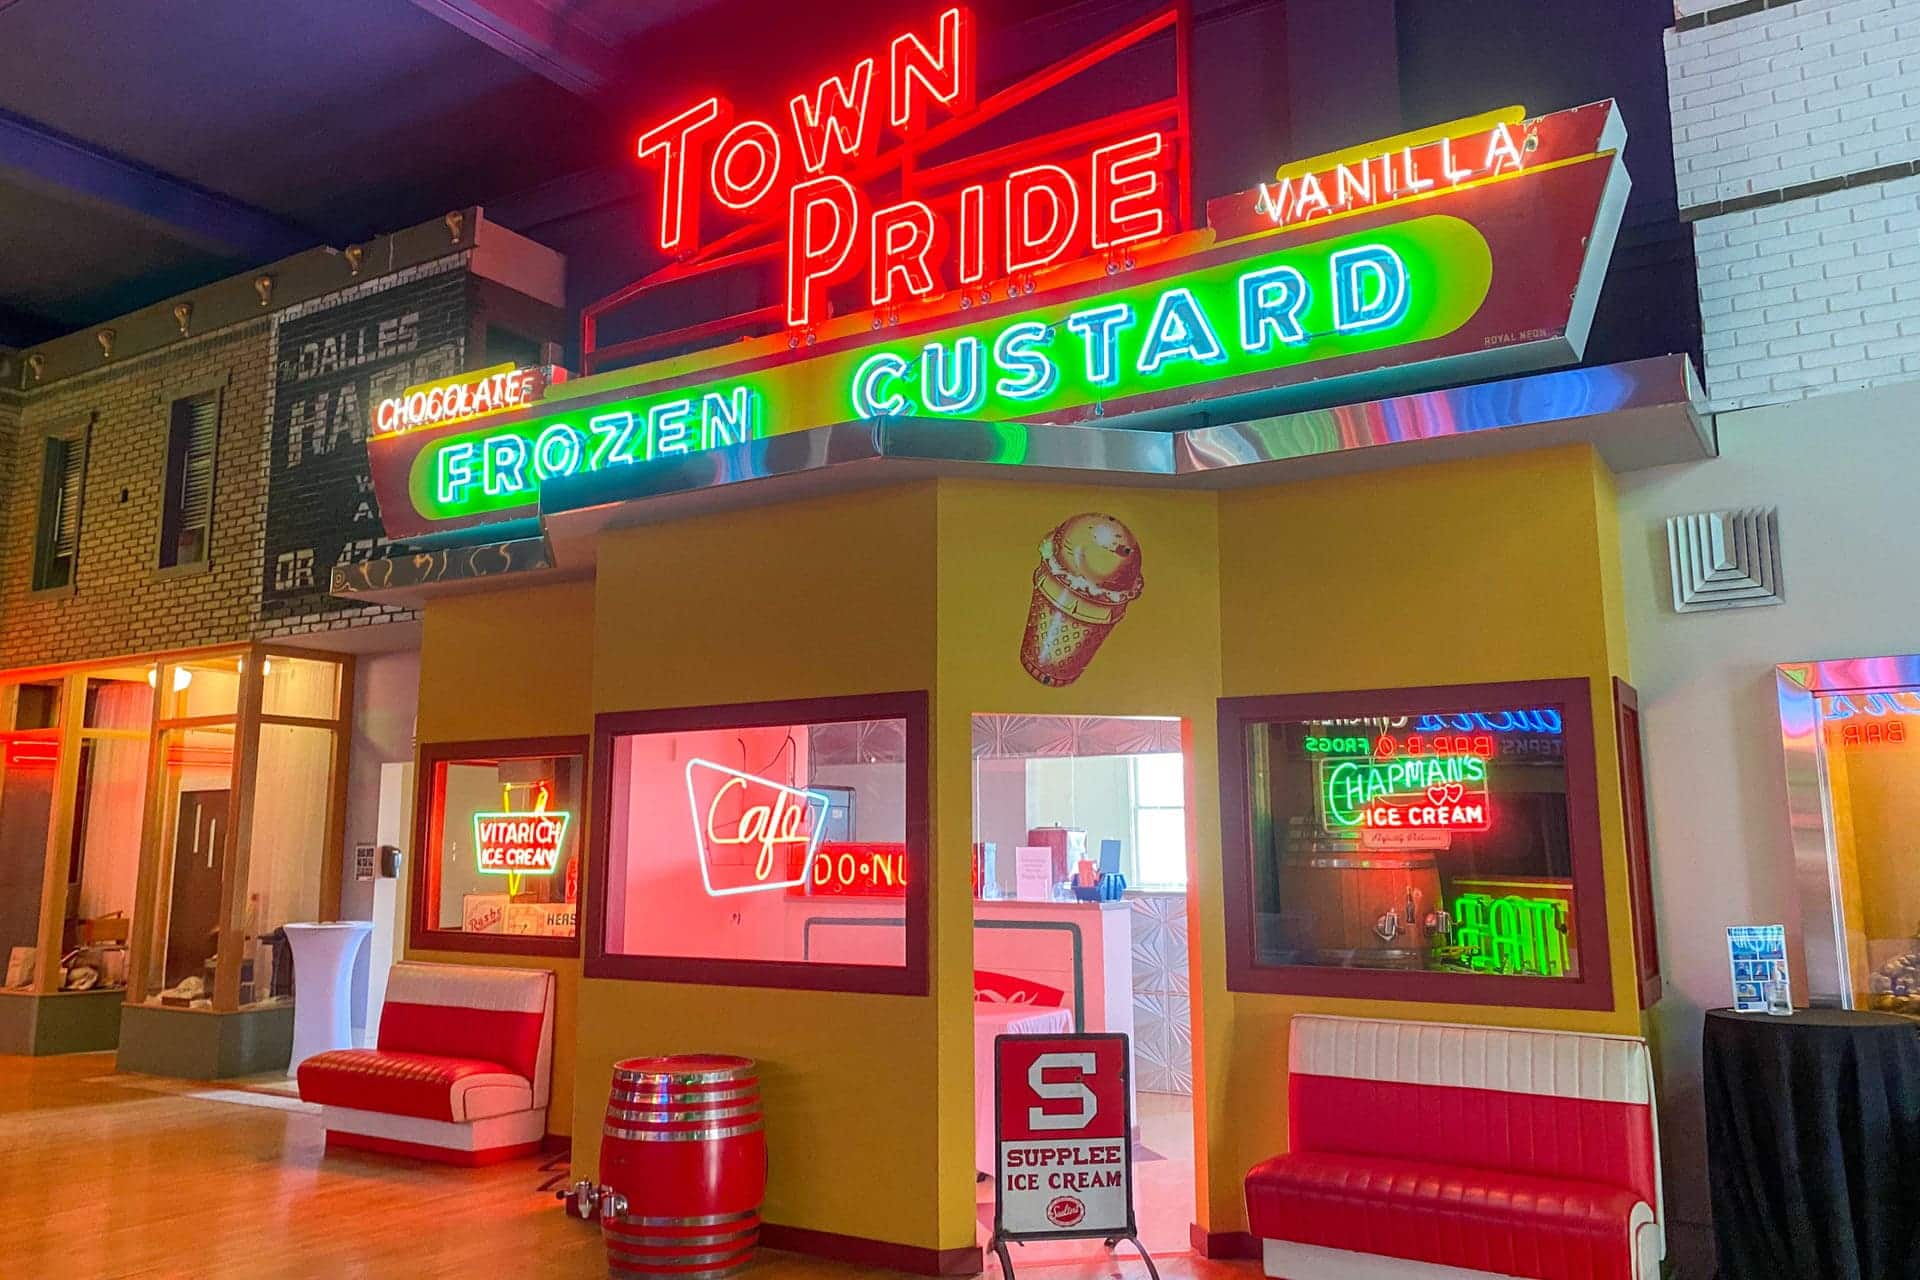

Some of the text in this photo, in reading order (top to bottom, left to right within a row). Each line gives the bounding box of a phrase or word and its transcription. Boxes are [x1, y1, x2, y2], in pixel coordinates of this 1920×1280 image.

[638, 8, 960, 249] TOWN
[1259, 121, 1522, 223] VANILLA
[788, 132, 1163, 326] PRIDE
[1484, 328, 1547, 345] ROYAL NEON
[377, 368, 532, 432] CHOCOLATE
[437, 243, 1408, 503] FROZEN CUSTARD
[1330, 755, 1485, 826] CHAPMAN'S
[1367, 806, 1484, 827] ICE CREAM
[482, 848, 504, 865] ICE
[1027, 1051, 1098, 1131] S
[1007, 1145, 1121, 1168] SUPPLEE
[1007, 1170, 1122, 1193] ICE CREAM
